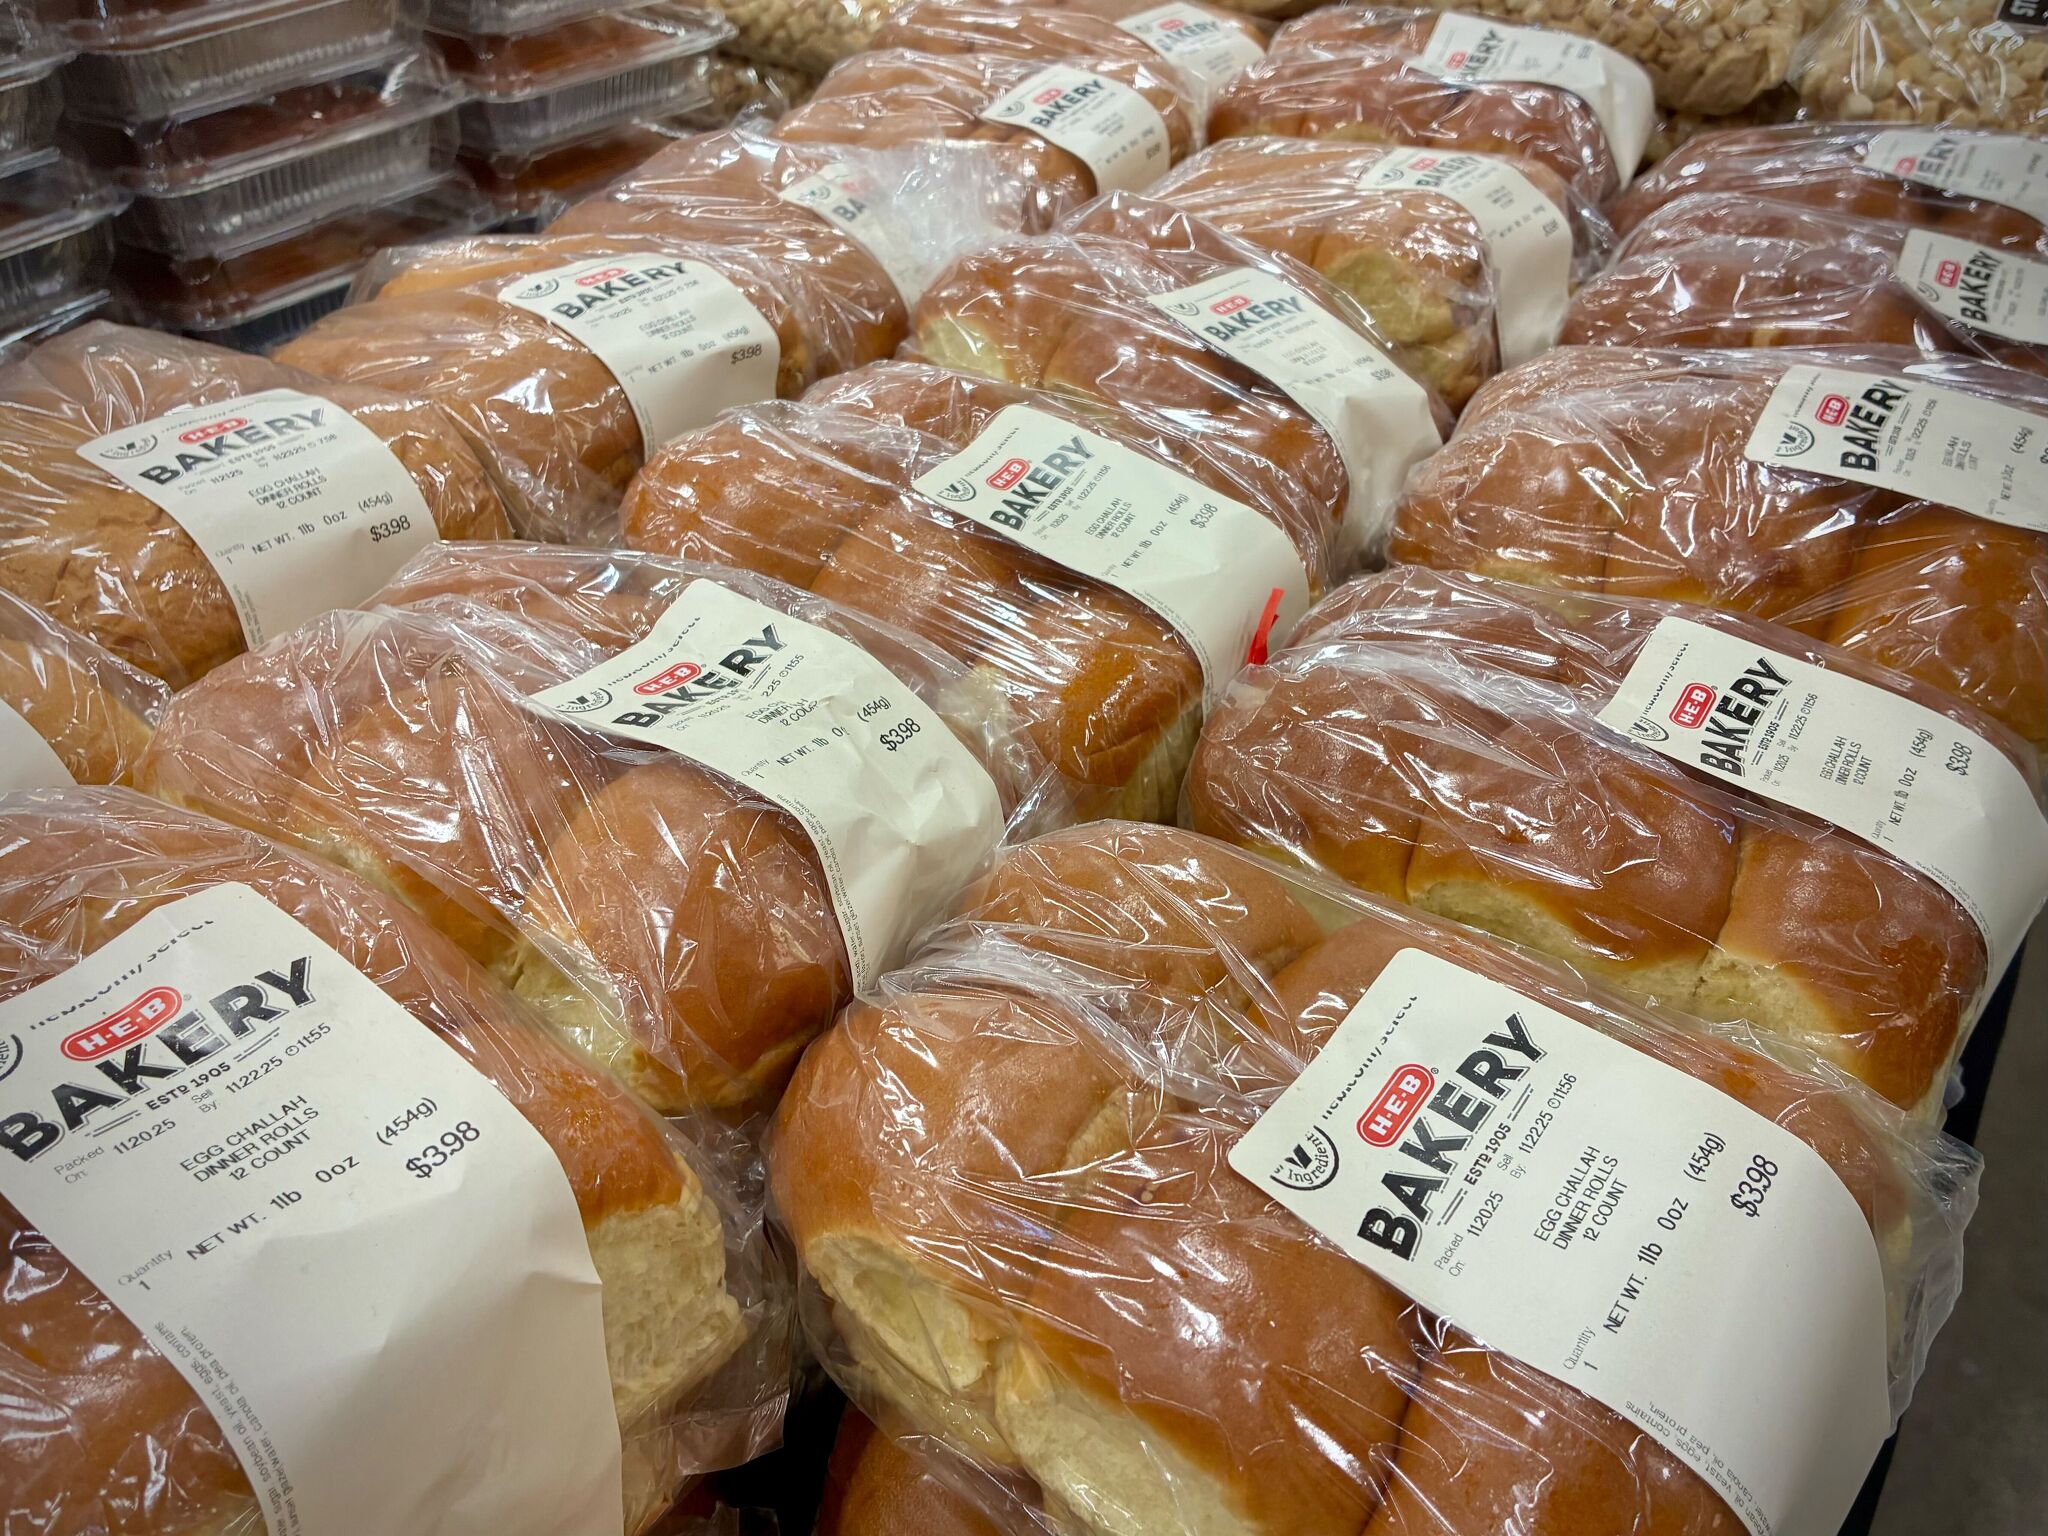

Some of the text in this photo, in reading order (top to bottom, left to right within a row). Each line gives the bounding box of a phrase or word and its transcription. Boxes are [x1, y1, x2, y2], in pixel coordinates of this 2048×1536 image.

[1029, 78, 1104, 126] BAKERY
[550, 260, 686, 318] BAKERY
[1958, 250, 2001, 322] BAKERY
[1202, 292, 1304, 343] BAKERY
[1837, 377, 1910, 474] BAKERY
[138, 405, 327, 486] BAKERY
[273, 467, 320, 488] CHALLAH
[288, 487, 322, 505] COUNT
[988, 433, 1096, 532] BAKERY
[252, 540, 272, 554] NET
[274, 532, 291, 544] WT.
[322, 511, 347, 525] 0oz
[358, 491, 393, 513] (454g)
[368, 514, 411, 544] $3.98
[1084, 498, 1122, 535] EGG CHALLAH
[1111, 502, 1132, 522] ROLLS
[1115, 512, 1136, 532] COUNT
[1190, 503, 1218, 528] $3.98
[1121, 558, 1134, 568] NET
[610, 623, 785, 729] BAKERY
[776, 752, 796, 766] NET
[796, 745, 814, 756] WT.
[856, 696, 891, 722] (454g)
[880, 718, 920, 752] $3.98
[1698, 655, 1791, 777] BAKERY
[1758, 721, 1780, 750] ESTD 1905
[1842, 741, 1862, 768] ROLLS
[1908, 728, 1934, 758] (454g)
[741, 759, 770, 776] Quantity
[1819, 736, 1847, 780] EGG CHALLAH
[1854, 755, 1872, 780] COUNT
[1898, 767, 1917, 787] 0oz
[1945, 742, 1972, 776] $3.98
[1888, 810, 1902, 826] NET
[1892, 800, 1906, 812] WT.
[77, 995, 167, 1054] H-E-B
[0, 952, 317, 1162] BAKERY
[145, 1062, 230, 1110] ESTD 1905
[191, 1088, 214, 1104] Sell
[1366, 1070, 1426, 1139] H-E-B
[179, 1095, 307, 1171] EGG CHALLAH
[193, 1107, 319, 1182] DINNER ROLLS
[406, 1121, 480, 1178] $3.98
[1354, 1010, 1548, 1260] BAKERY
[53, 1146, 104, 1175] Packed
[228, 1128, 310, 1180] 12 COUNT
[1463, 1122, 1511, 1185] ESTD 1905
[1496, 1153, 1514, 1171] Sell
[186, 1097, 437, 1260] NET WT. 1lb 0oz (454g)
[1533, 1146, 1600, 1241] EGG CHALLAH
[1730, 1154, 1778, 1218] $3.98
[1552, 1156, 1618, 1250] DINNER ROLLS
[1582, 1177, 1627, 1241] 12 COUNT
[1433, 1232, 1464, 1270] Packed
[1603, 1132, 1726, 1334] NET WT. 1lb 0oz (454g)
[117, 1250, 172, 1286] Quantity
[139, 1280, 150, 1290] 1
[154, 1322, 191, 1358] contains
[1563, 1326, 1596, 1370] Quantity
[210, 1359, 229, 1380] pea
[1584, 1361, 1598, 1370] 1
[236, 1396, 263, 1432] canola
[1625, 1400, 1670, 1437] contains
[1650, 1401, 1688, 1436] protein,
[243, 1436, 272, 1483] soybean
[1689, 1435, 1710, 1456] pea
